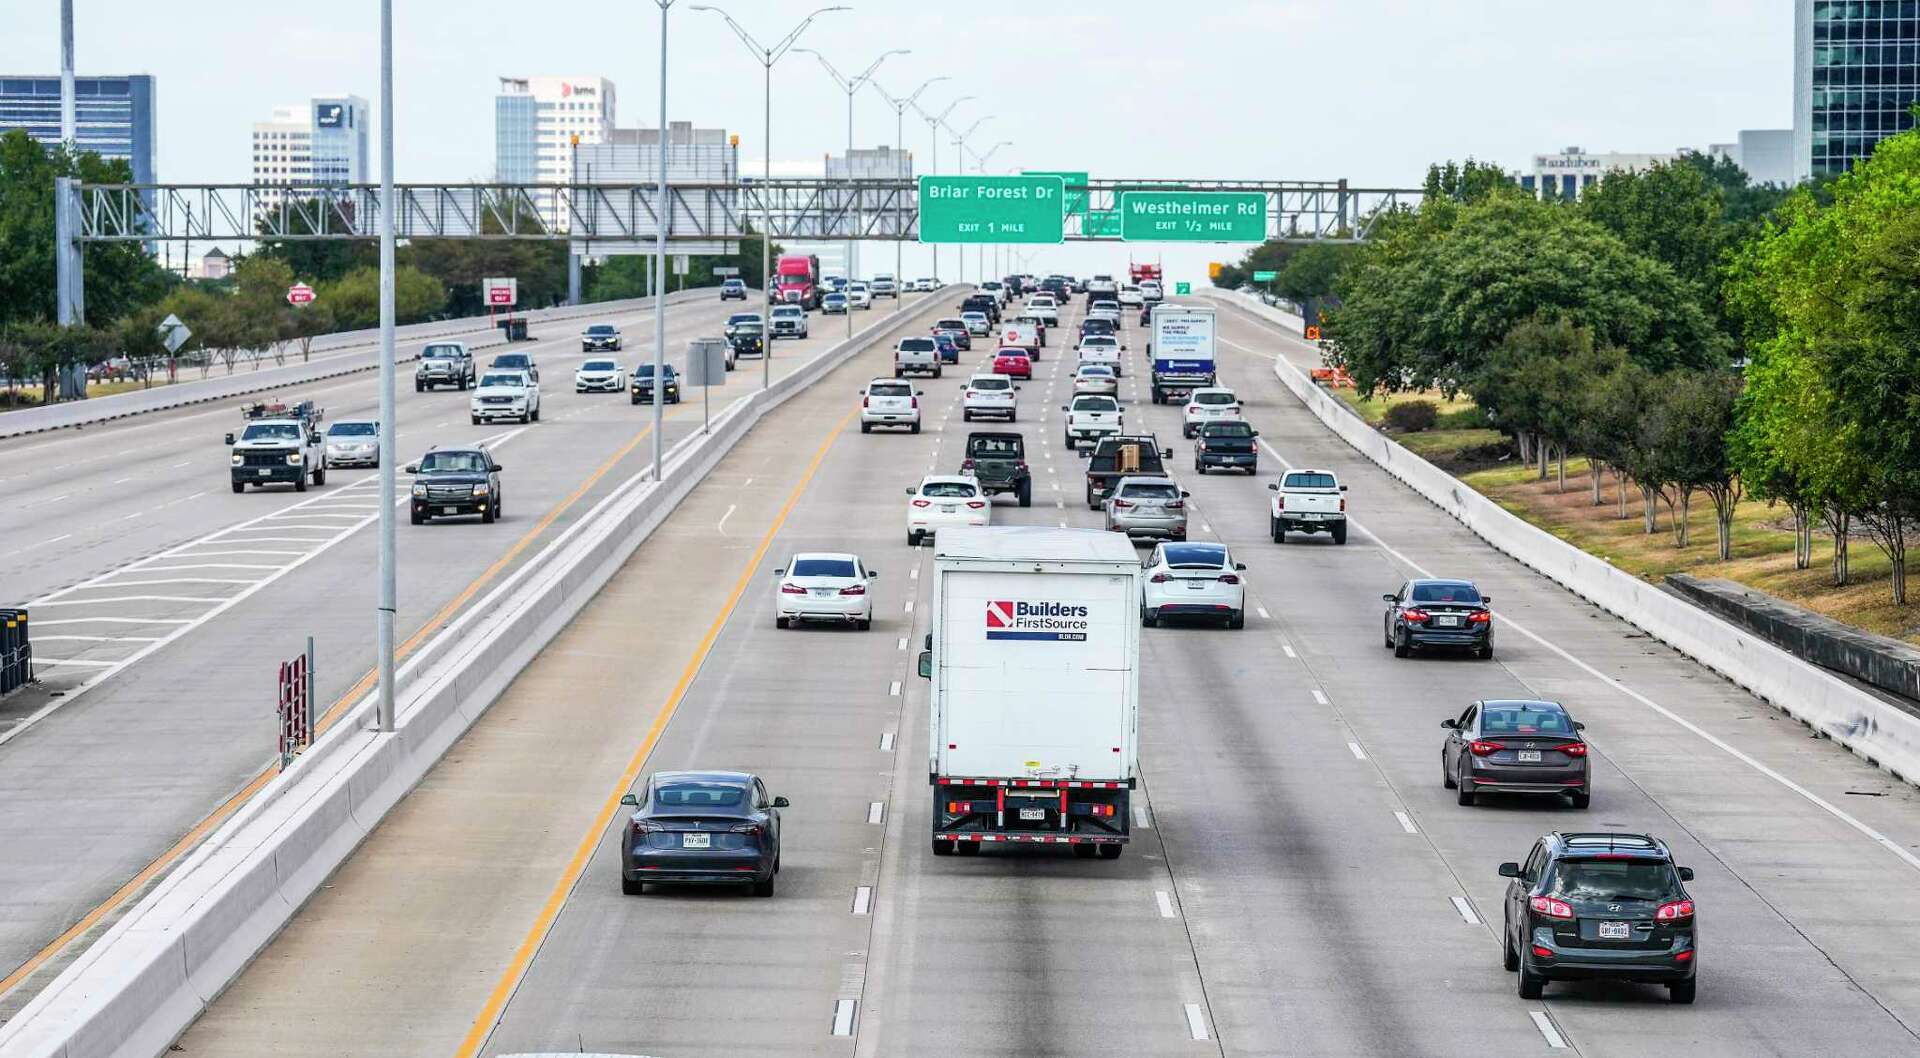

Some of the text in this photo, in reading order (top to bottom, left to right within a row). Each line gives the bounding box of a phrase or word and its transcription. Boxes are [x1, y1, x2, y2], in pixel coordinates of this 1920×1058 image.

[929, 184, 970, 199] Briar
[977, 185, 1028, 199] Forest
[1035, 186, 1055, 199] Dr
[1132, 201, 1257, 215] Westheimer Rd
[958, 221, 1025, 233] EXIT 1 MILE
[1155, 221, 1177, 230] EXIT
[1209, 221, 1232, 231] MILE
[1016, 602, 1088, 617] Builders
[1016, 617, 1088, 630] FirstSource
